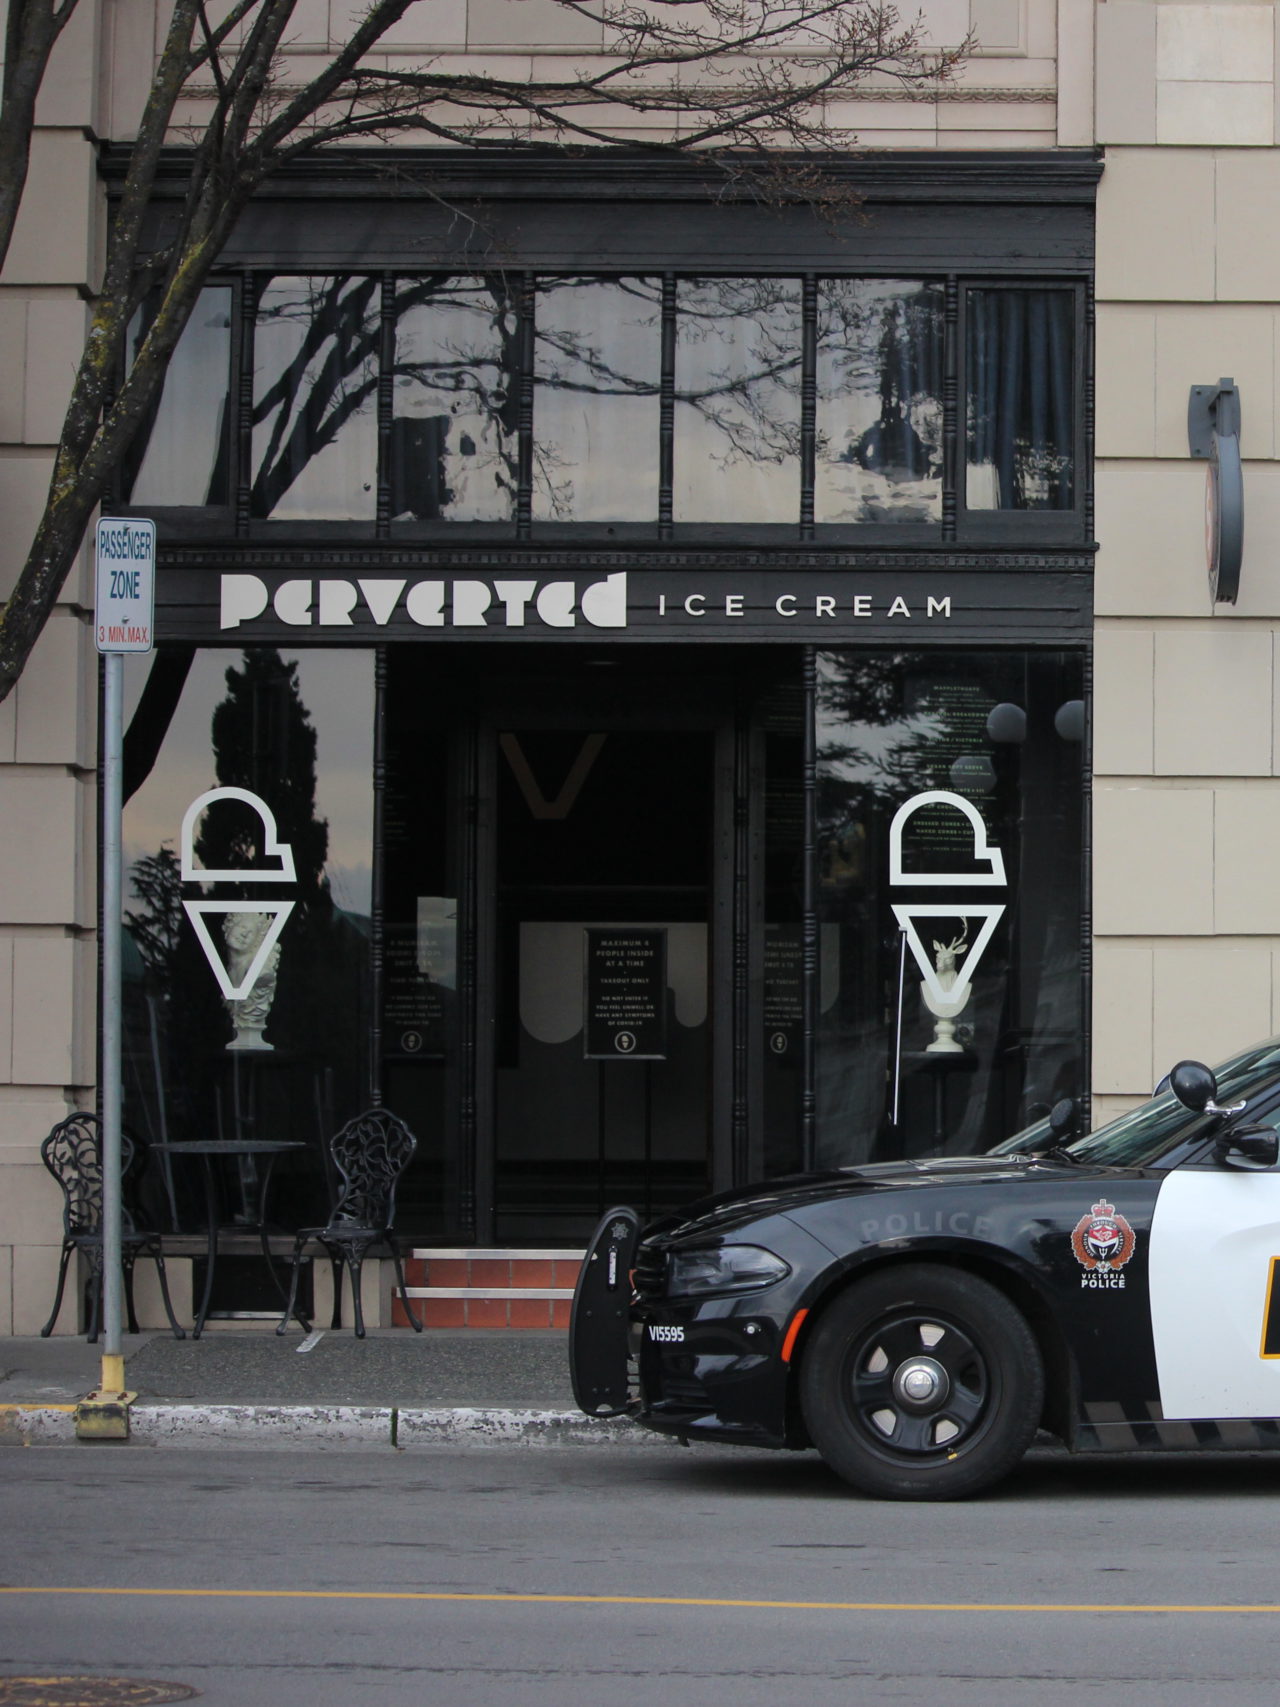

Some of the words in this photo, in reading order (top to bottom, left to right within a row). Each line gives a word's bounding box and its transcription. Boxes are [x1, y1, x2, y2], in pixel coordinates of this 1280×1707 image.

[100, 530, 151, 560] PASSENGER
[110, 570, 140, 600] ZONE
[659, 594, 745, 617] ICE
[775, 594, 951, 618] CREAM
[99, 625, 104, 642] 3
[860, 1211, 993, 1241] POLICE
[1081, 1279, 1126, 1288] POLICE
[649, 1325, 685, 1342] VI5595
